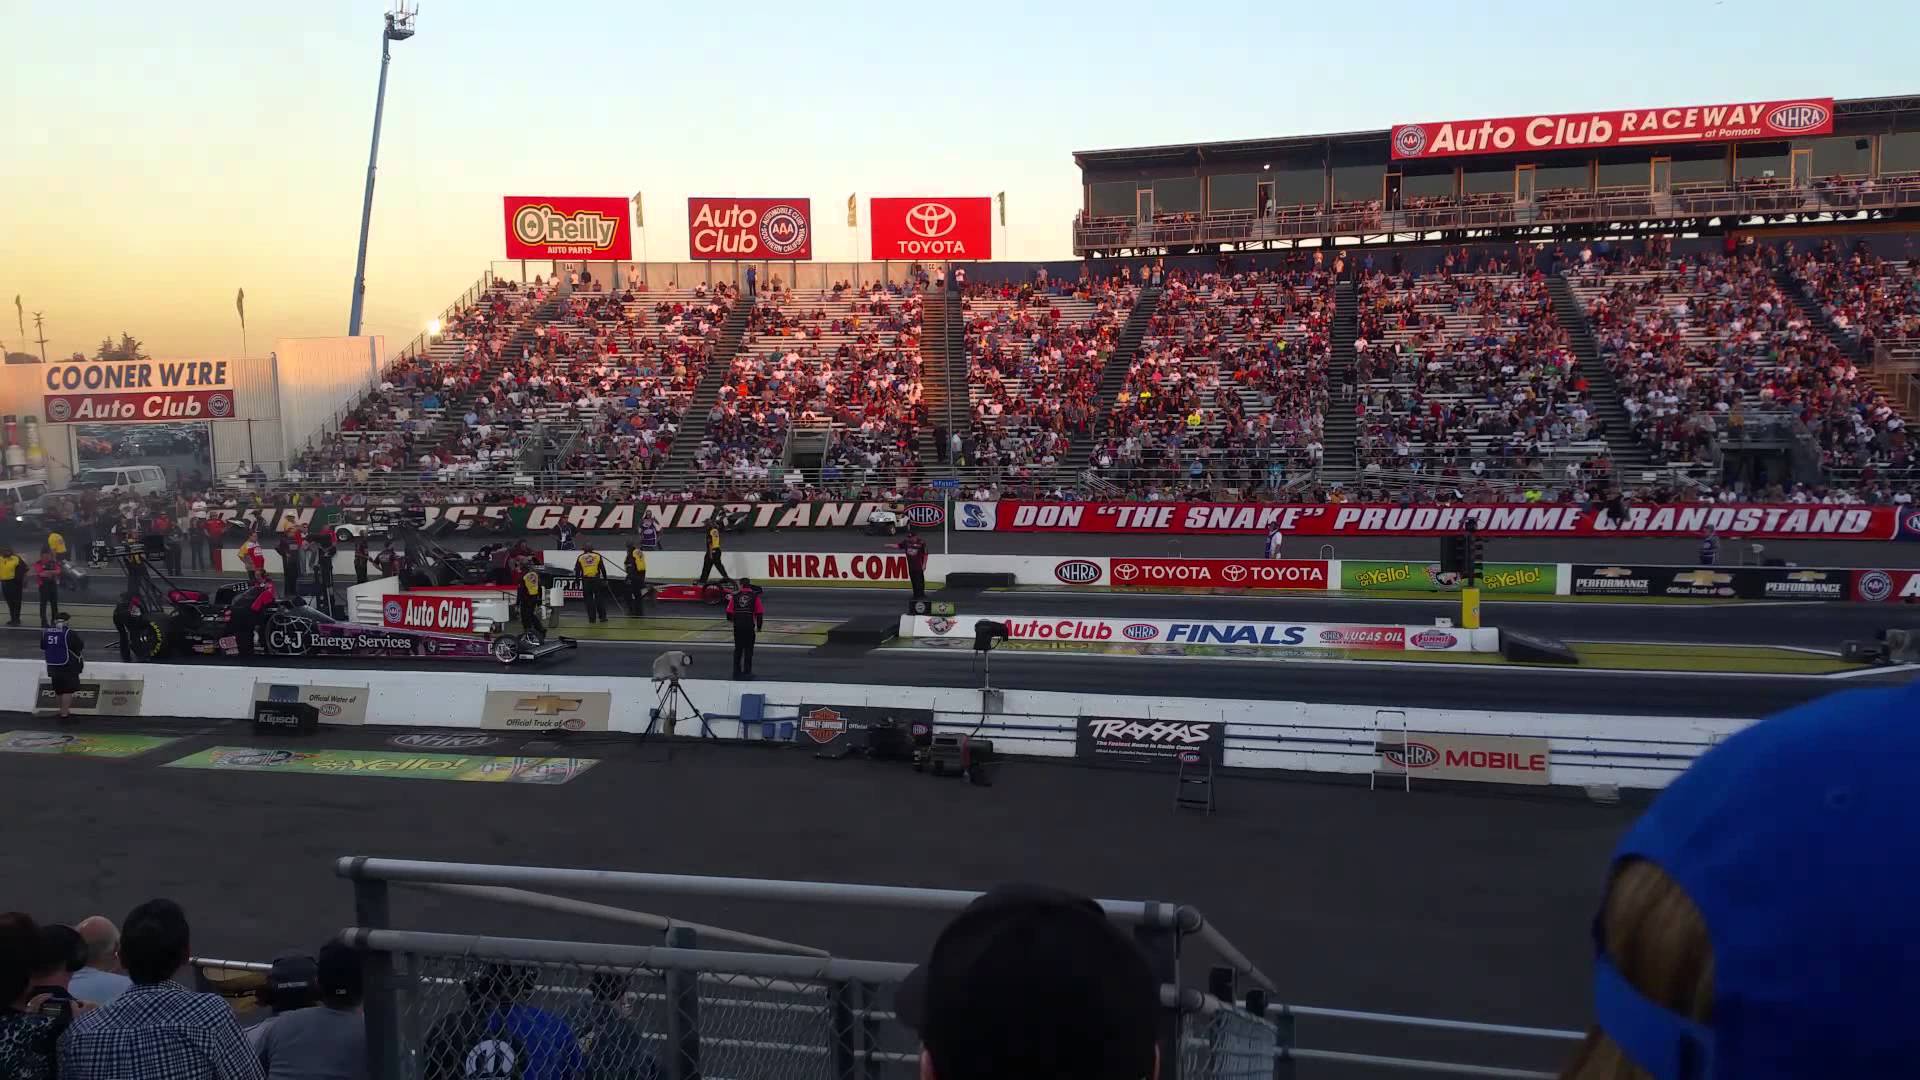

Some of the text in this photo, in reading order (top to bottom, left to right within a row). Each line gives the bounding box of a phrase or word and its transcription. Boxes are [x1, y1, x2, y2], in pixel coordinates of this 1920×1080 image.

[1429, 121, 1516, 153] Auto
[1525, 116, 1613, 147] Club
[1620, 104, 1766, 132] RACEWAY
[1775, 108, 1821, 127] NHRA
[1705, 127, 1761, 138] at Pomona
[693, 203, 757, 228] Auto
[518, 209, 612, 244] O'Reilly
[772, 222, 795, 235] AAA
[547, 246, 593, 254] AUTO PARTS
[695, 229, 758, 253] Club
[897, 240, 965, 254] TOYOTA
[47, 361, 227, 390] COONER WIRE
[74, 397, 136, 419] Auto
[143, 396, 201, 418] Club
[907, 508, 940, 522] NHRA
[1013, 505, 1085, 528] DON
[768, 554, 911, 580] NHRA.COM
[1060, 564, 1097, 580] NHRA
[1142, 565, 1323, 581] TOYOTA TOYOTA
[1369, 565, 1410, 583] Yello!
[1497, 568, 1540, 587] Yello!
[1576, 578, 1649, 588] PERFORMANCE
[1765, 582, 1841, 592] PERFORMANCE
[404, 599, 470, 628] Auto Club
[47, 635, 58, 645] 51
[270, 630, 411, 650] C&J Energy Services
[1126, 626, 1156, 638] NHRA
[1166, 623, 1307, 645] FINALS
[1344, 631, 1382, 642] LUCAS
[1384, 632, 1403, 642] OIL
[331, 695, 348, 703] Water
[259, 713, 298, 725] Klipsch
[506, 718, 532, 727] Official
[533, 719, 551, 727] Truck
[553, 719, 562, 728] of
[1088, 719, 1212, 743] TRAXXAS
[1445, 749, 1546, 771] MOBILE
